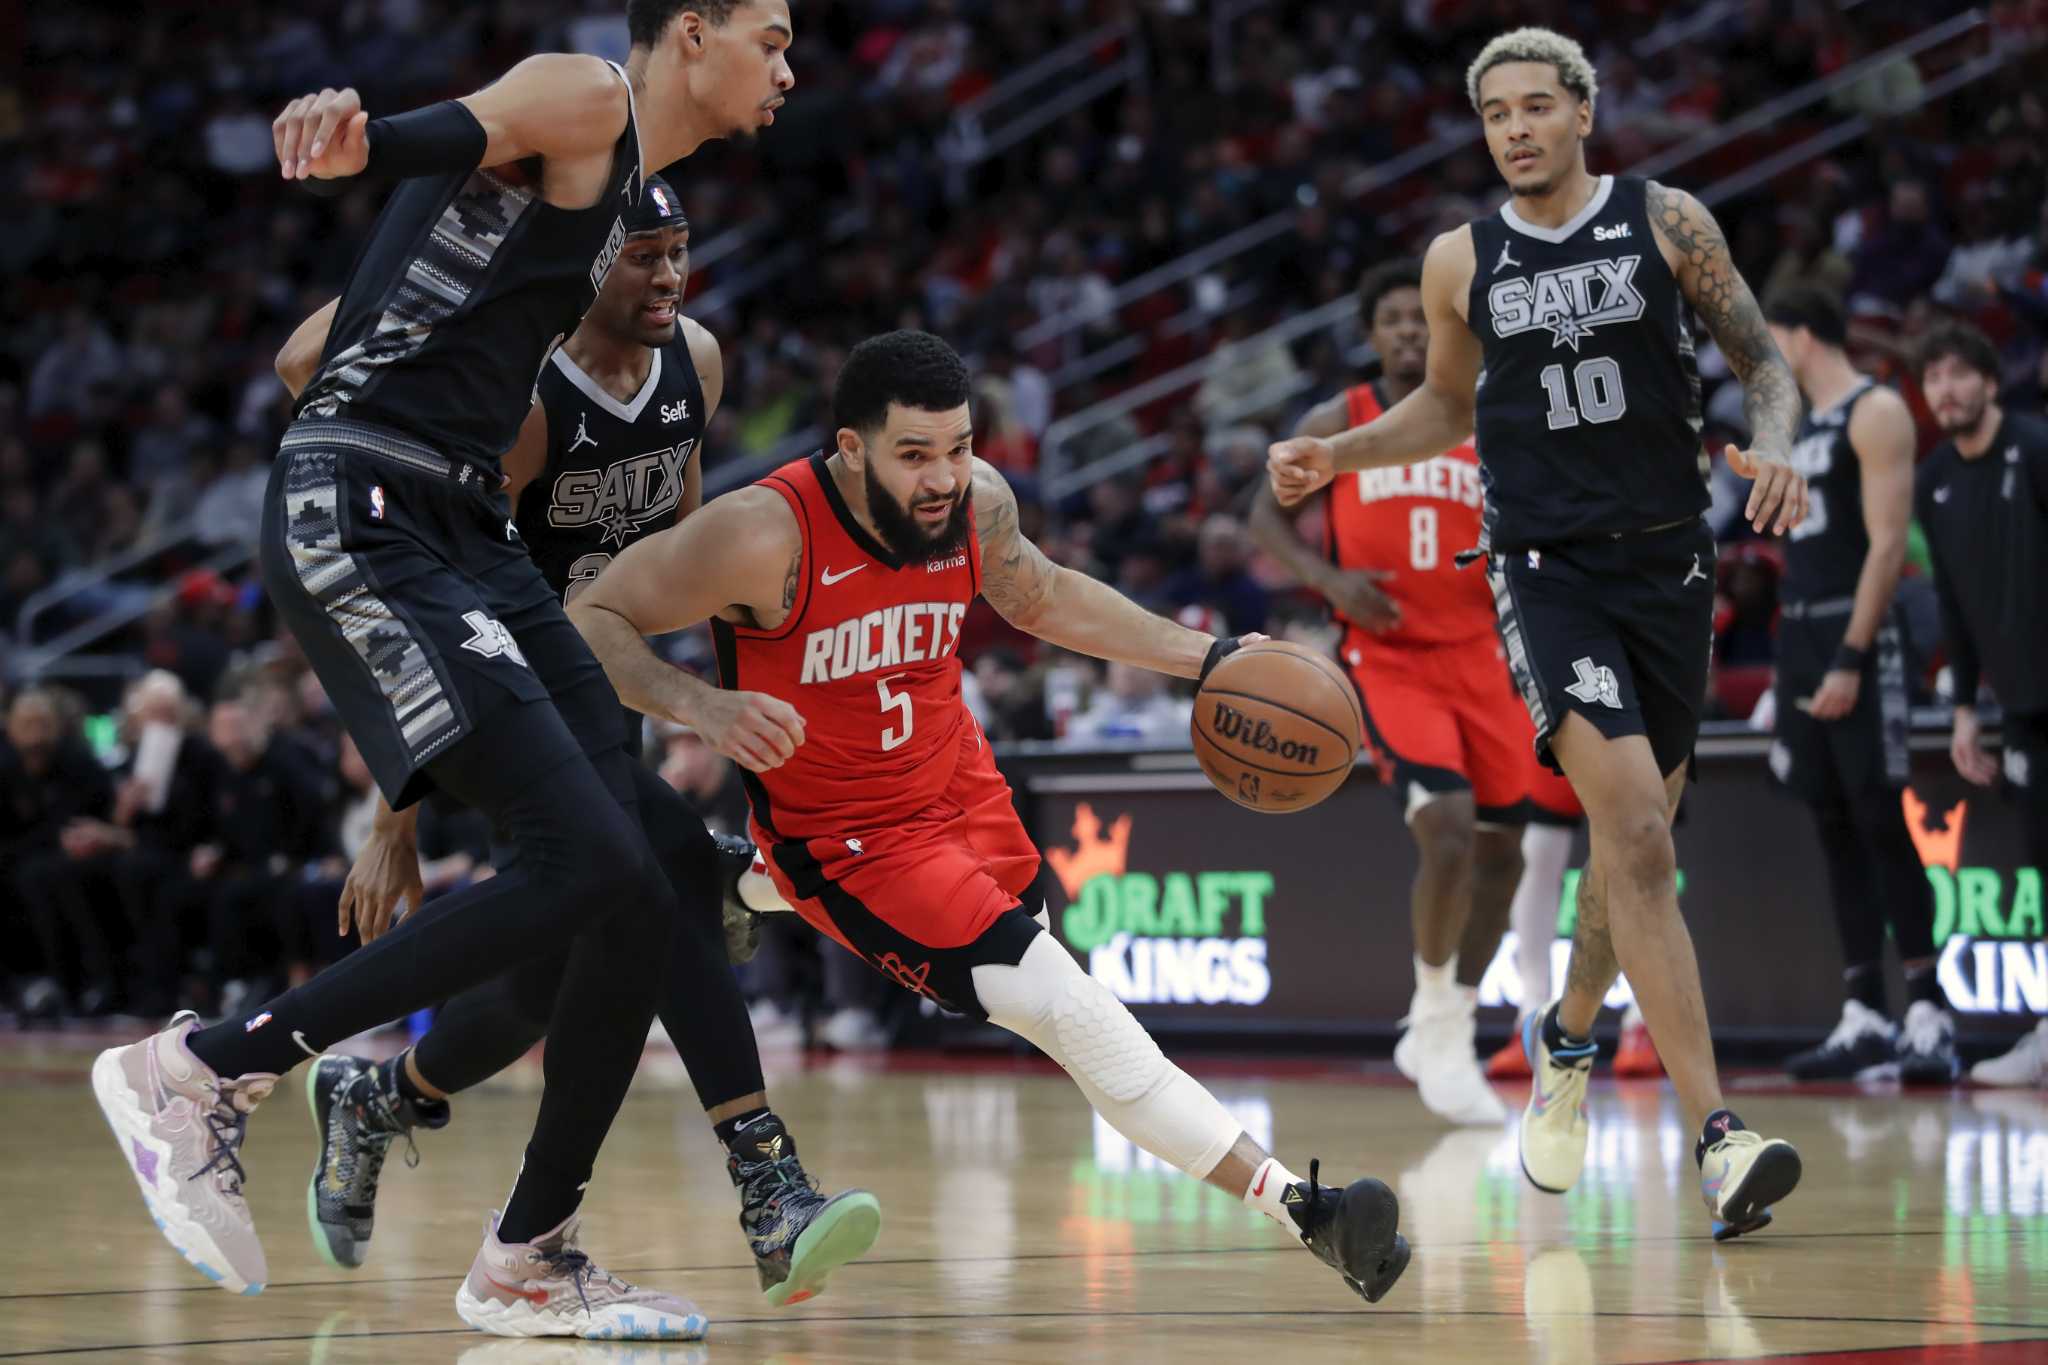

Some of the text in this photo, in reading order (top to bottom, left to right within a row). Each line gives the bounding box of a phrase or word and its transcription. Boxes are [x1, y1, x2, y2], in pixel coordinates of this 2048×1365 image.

[1488, 255, 1646, 339] SATX
[1540, 356, 1627, 430] 10
[547, 438, 694, 527] SATX
[926, 555, 966, 574] karma
[1410, 506, 1438, 571] 8
[801, 602, 967, 684] ROCKETS
[876, 672, 913, 752] 5
[1214, 702, 1320, 766] Wilson
[1063, 871, 1275, 953] DRAFT
[1089, 930, 1272, 1005] KINGS
